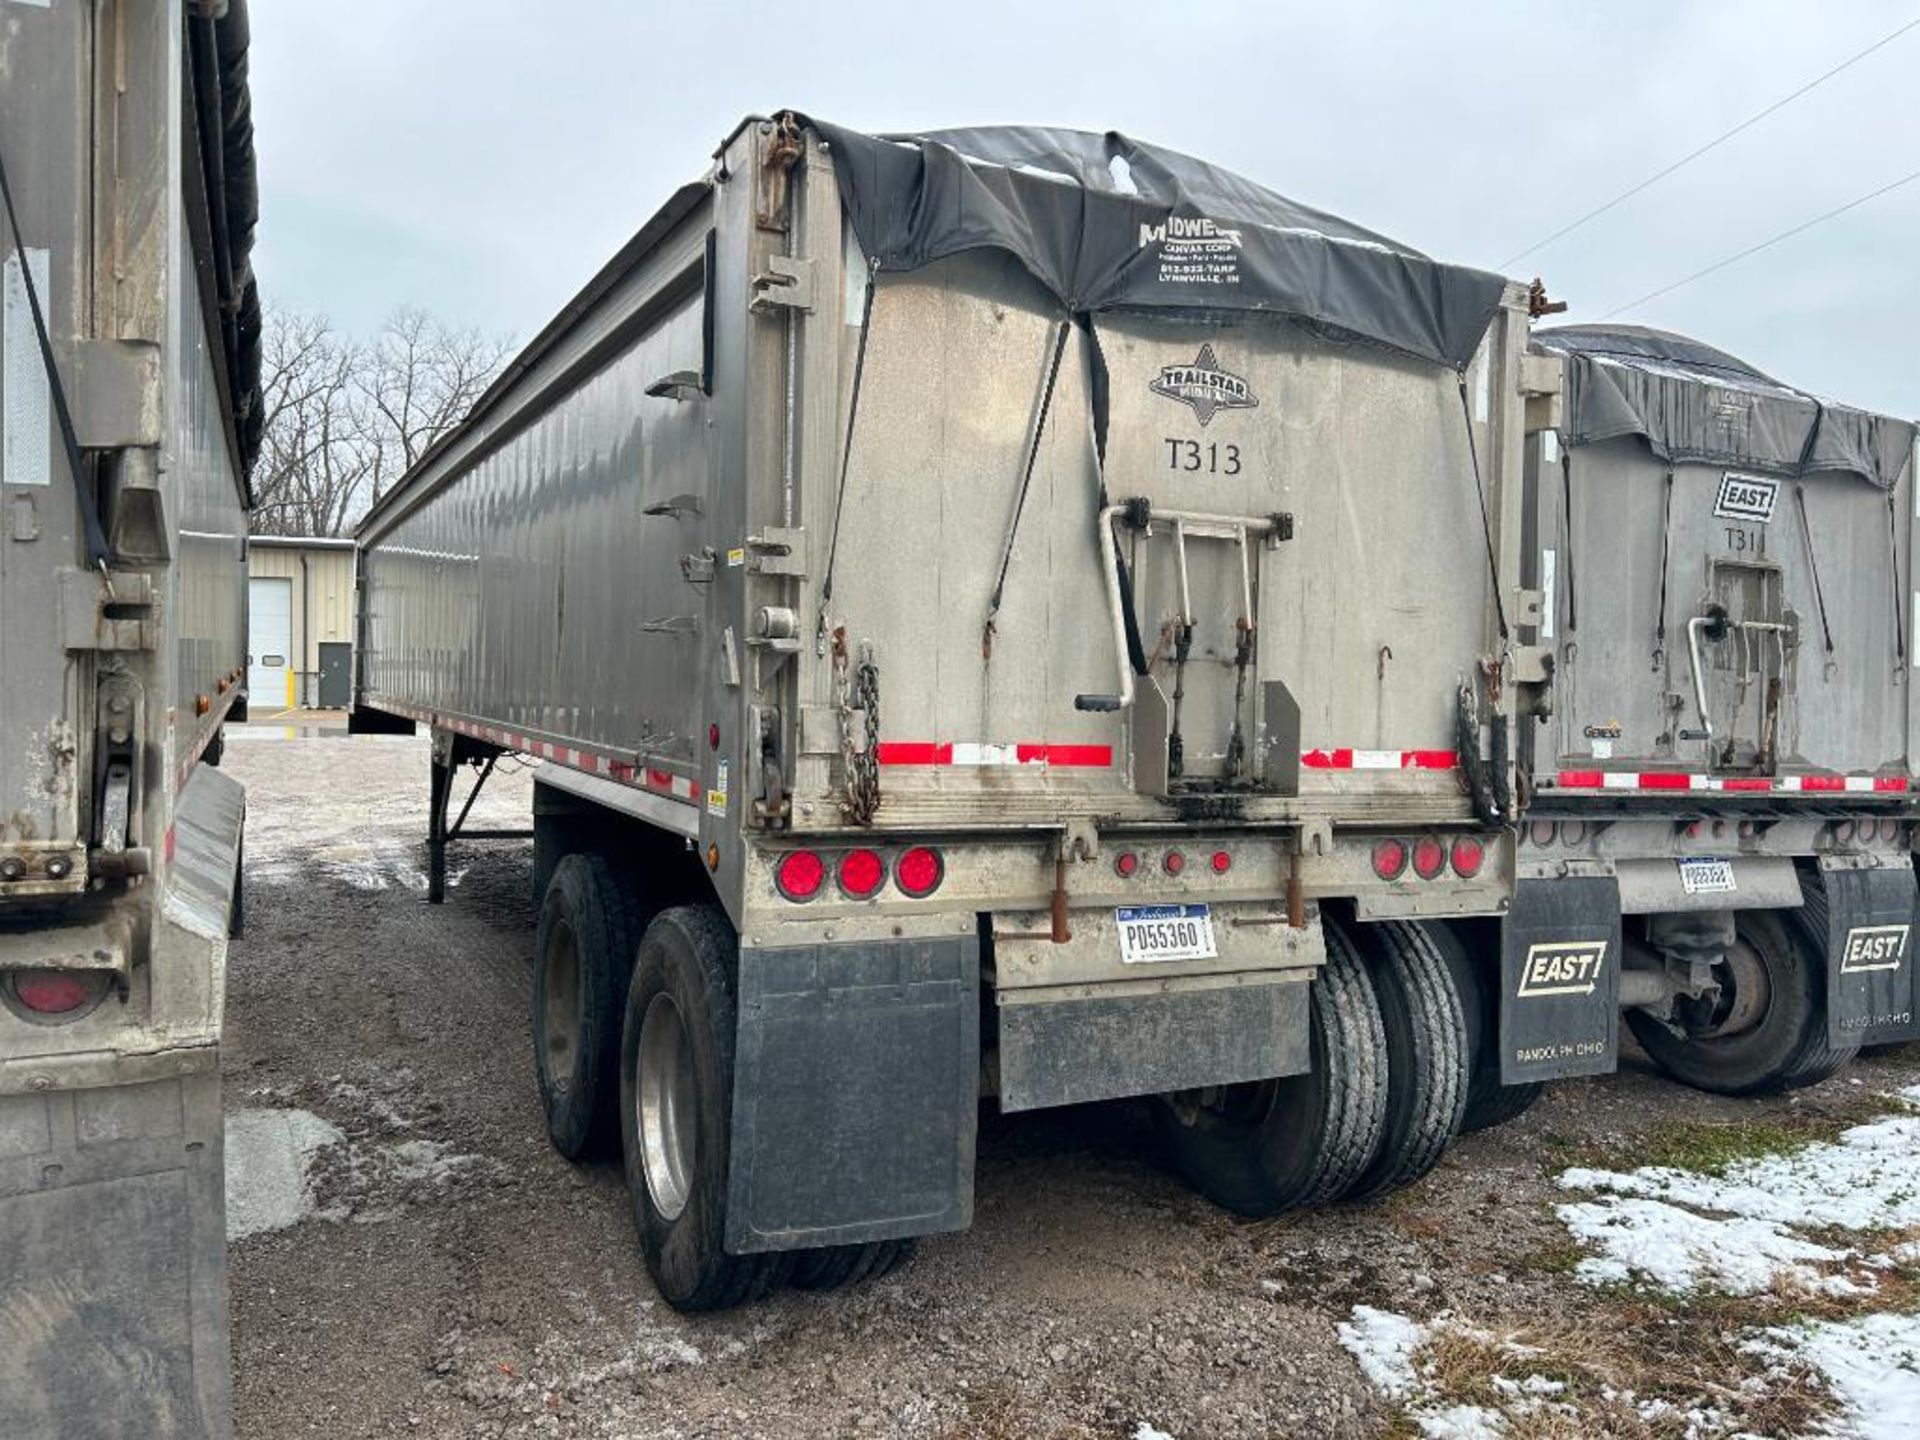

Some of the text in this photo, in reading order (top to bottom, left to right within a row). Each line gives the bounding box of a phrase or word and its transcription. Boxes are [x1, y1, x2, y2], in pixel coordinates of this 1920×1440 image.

[1165, 371, 1245, 397] TRAILSTAR
[1165, 438, 1241, 475] T313
[1727, 486, 1768, 508] EAST
[1127, 922, 1198, 950] PD55360
[1849, 936, 1899, 961] EAST
[1530, 955, 1594, 982] EAST
